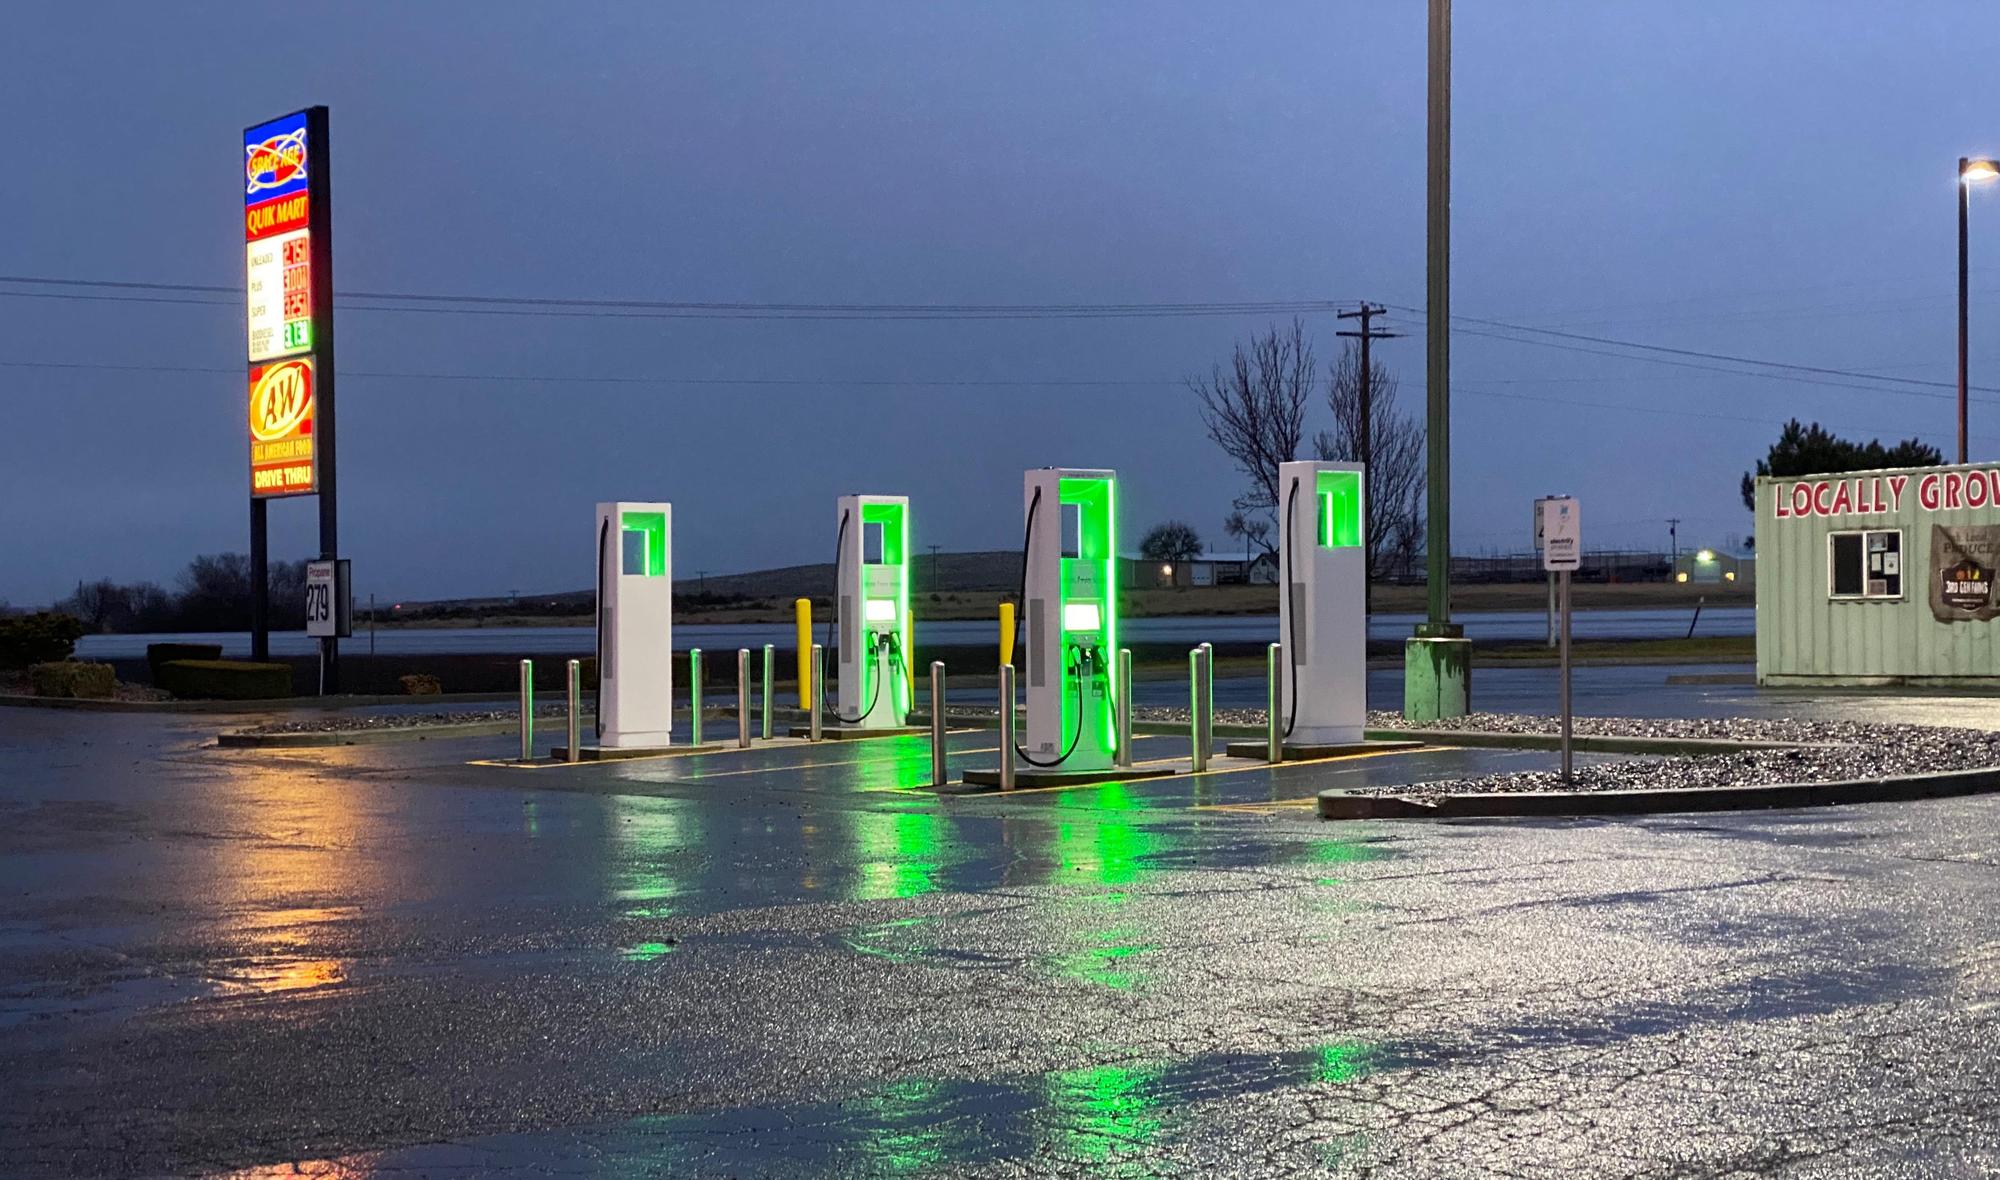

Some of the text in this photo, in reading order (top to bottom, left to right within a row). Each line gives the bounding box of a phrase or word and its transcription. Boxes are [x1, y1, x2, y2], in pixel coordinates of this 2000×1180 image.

[248, 196, 306, 236] QUIK MART
[255, 466, 311, 488] DRIVE THRU
[1775, 475, 1908, 519] LOCALLY
[307, 583, 329, 621] 279
